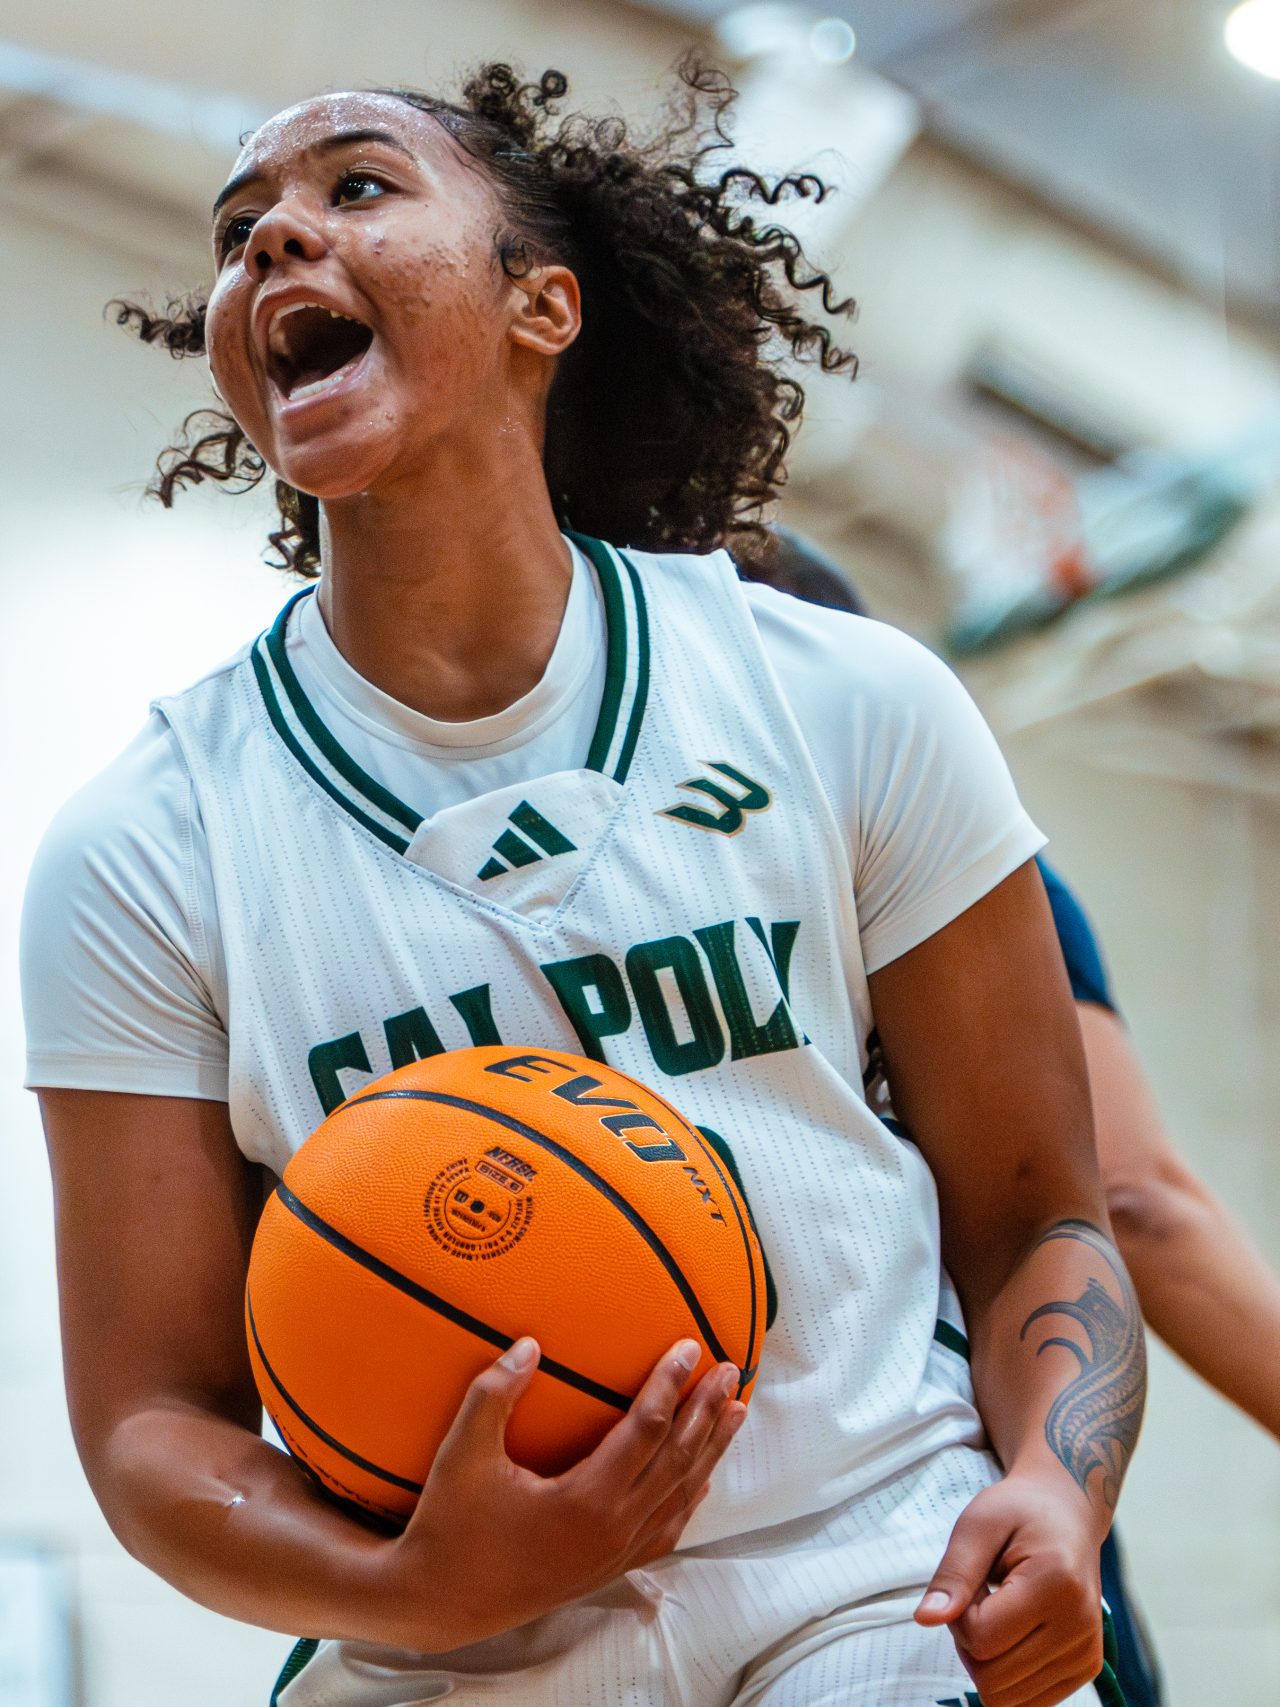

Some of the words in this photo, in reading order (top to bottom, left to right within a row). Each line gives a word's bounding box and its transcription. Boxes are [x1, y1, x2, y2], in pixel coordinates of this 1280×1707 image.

[540, 917, 812, 1078] POLY
[479, 1165, 508, 1183] SIZE
[483, 1053, 690, 1164] EVO
[682, 1165, 729, 1229] NXT
